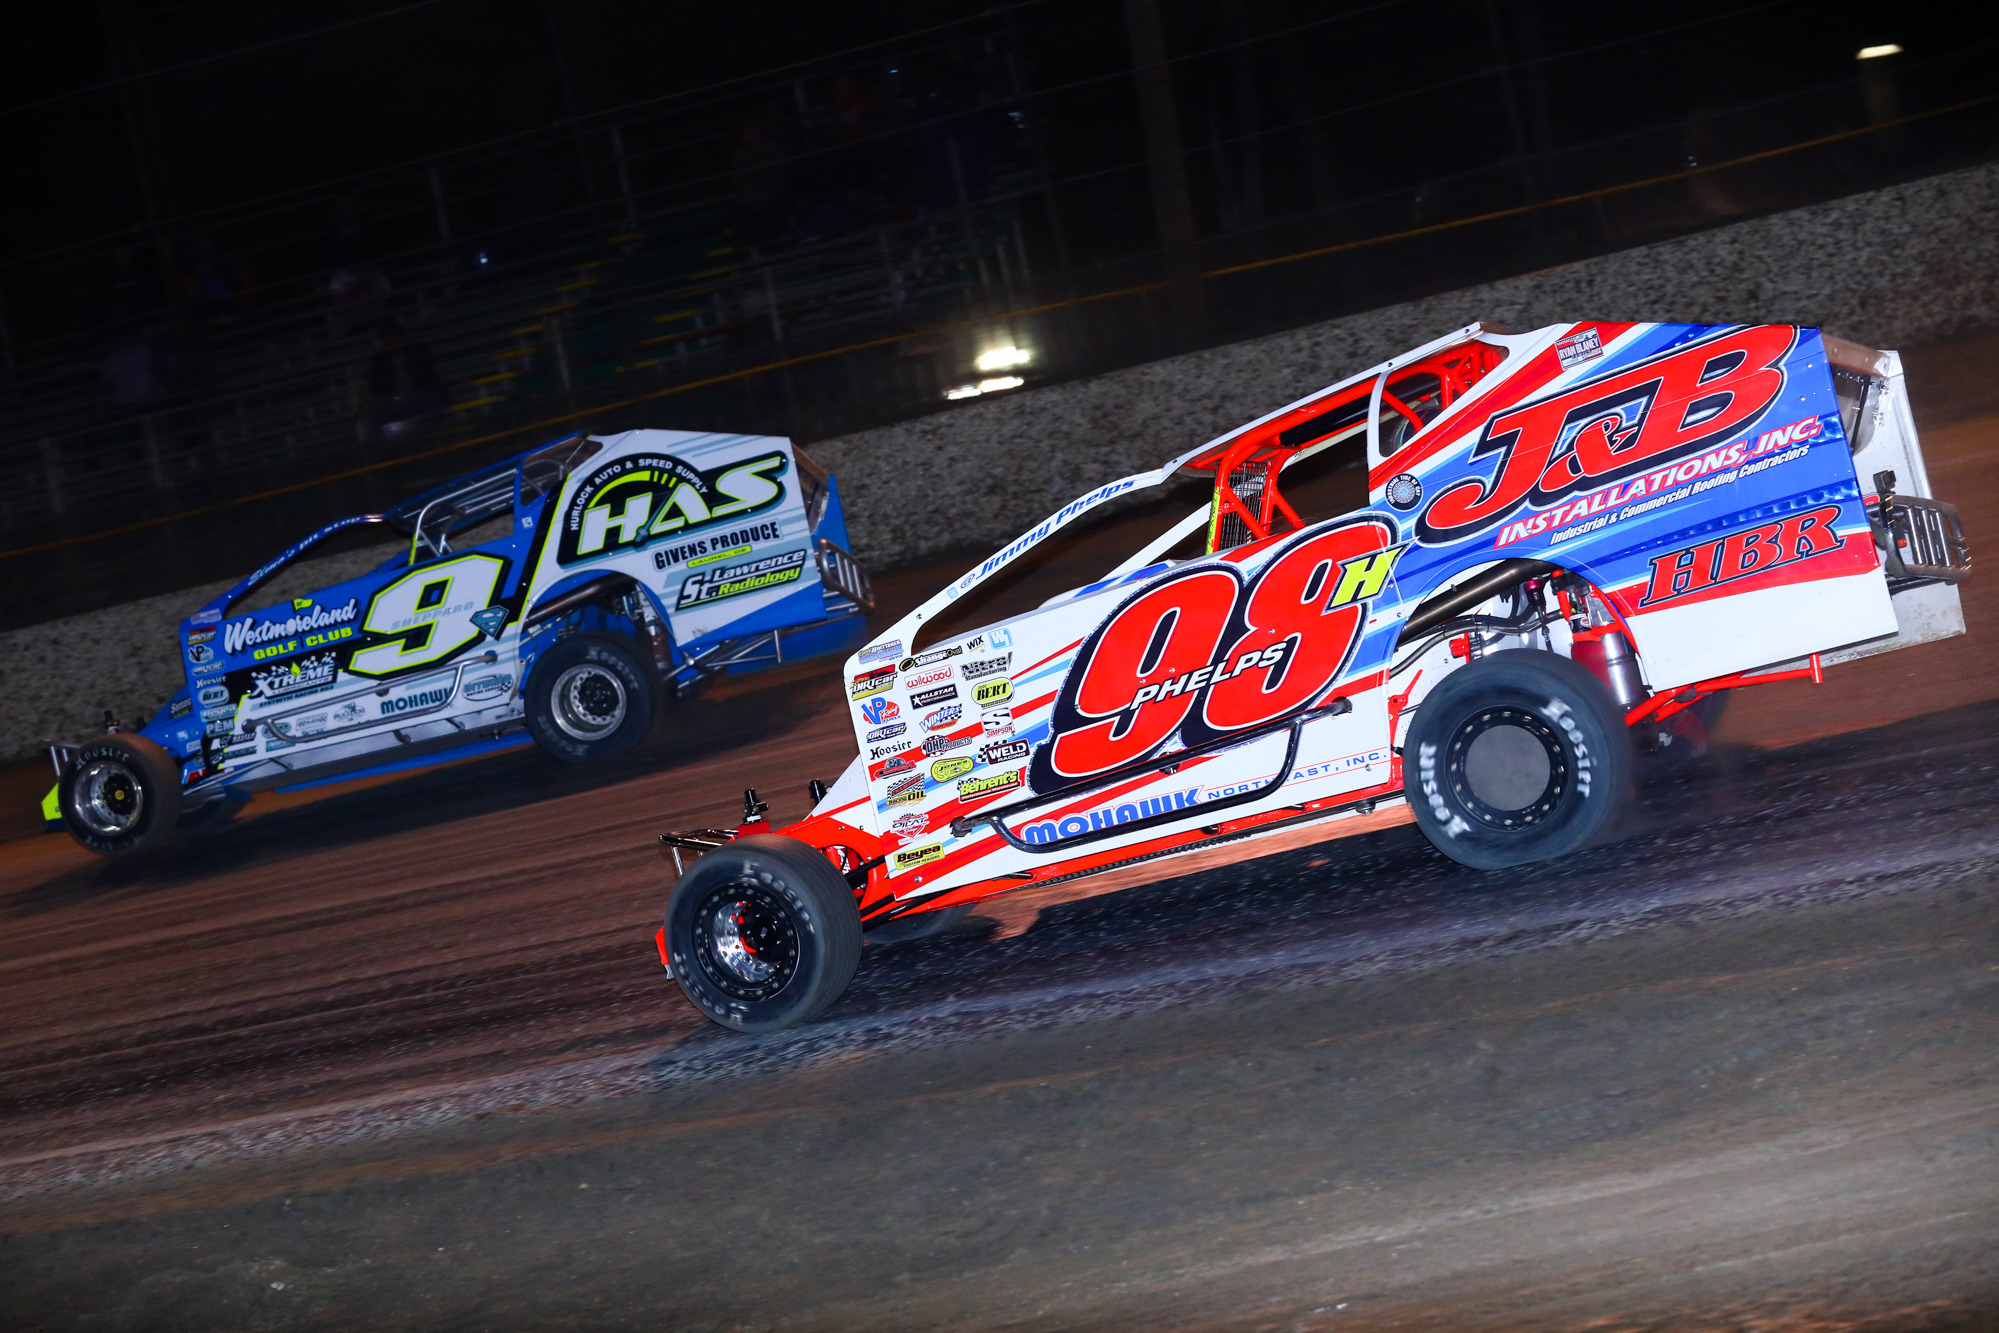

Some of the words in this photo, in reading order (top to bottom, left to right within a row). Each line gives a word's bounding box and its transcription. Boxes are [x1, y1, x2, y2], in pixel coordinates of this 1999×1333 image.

[1560, 343, 1577, 360] RYAN
[1575, 337, 1600, 353] BLANEY
[1414, 325, 1799, 545] J&B
[570, 484, 595, 531] HURLOCK
[595, 464, 621, 485] AUTO
[625, 460, 633, 469] &
[638, 458, 673, 470] SPEED
[675, 464, 709, 495] SUPPLY
[1496, 440, 1752, 549] INSTALLATIONS,
[1754, 415, 1823, 455] INC.
[1550, 518, 1607, 546] Industrial
[1609, 512, 1618, 524] &
[1619, 488, 1691, 522] Commercial
[1692, 471, 1738, 496] Roofing
[1739, 444, 1810, 478] Contractors
[577, 456, 782, 555] HAS
[1056, 480, 1136, 526] Phelps
[654, 540, 708, 570] GIVENS
[711, 521, 781, 555] PRODUCE
[1638, 506, 1846, 607] HBR
[680, 575, 717, 604] St.
[712, 550, 806, 583] Lawrence
[718, 567, 801, 595] Radiology
[224, 599, 358, 654] Westmoreland
[348, 554, 504, 676] 9
[391, 602, 475, 631] SHEPPARD
[253, 640, 299, 660] GOLF
[305, 627, 353, 647] CLUB
[966, 635, 984, 650] WIX
[1050, 518, 1396, 778] 98
[1328, 547, 1405, 610] H
[250, 662, 335, 699] XTREME
[907, 666, 952, 688] wilwood
[1130, 640, 1288, 711] PHELPS
[920, 686, 955, 700] ALLSTAR
[976, 682, 1008, 701] BERT
[861, 697, 887, 725] VP
[919, 705, 962, 733] WINTERS
[206, 721, 234, 735] PEM
[987, 725, 1013, 738] SIMPSON
[870, 741, 912, 760] Hoosier
[926, 737, 946, 753] DHP
[942, 736, 971, 750] PRODUCTS
[988, 742, 1028, 760] WELD
[997, 752, 1026, 762] RACING
[908, 790, 926, 801] OIL
[961, 771, 1018, 795] Behrent's
[1023, 786, 1202, 845] MOHAWK
[1346, 752, 1388, 769] INC.
[897, 845, 941, 863] Beyea
